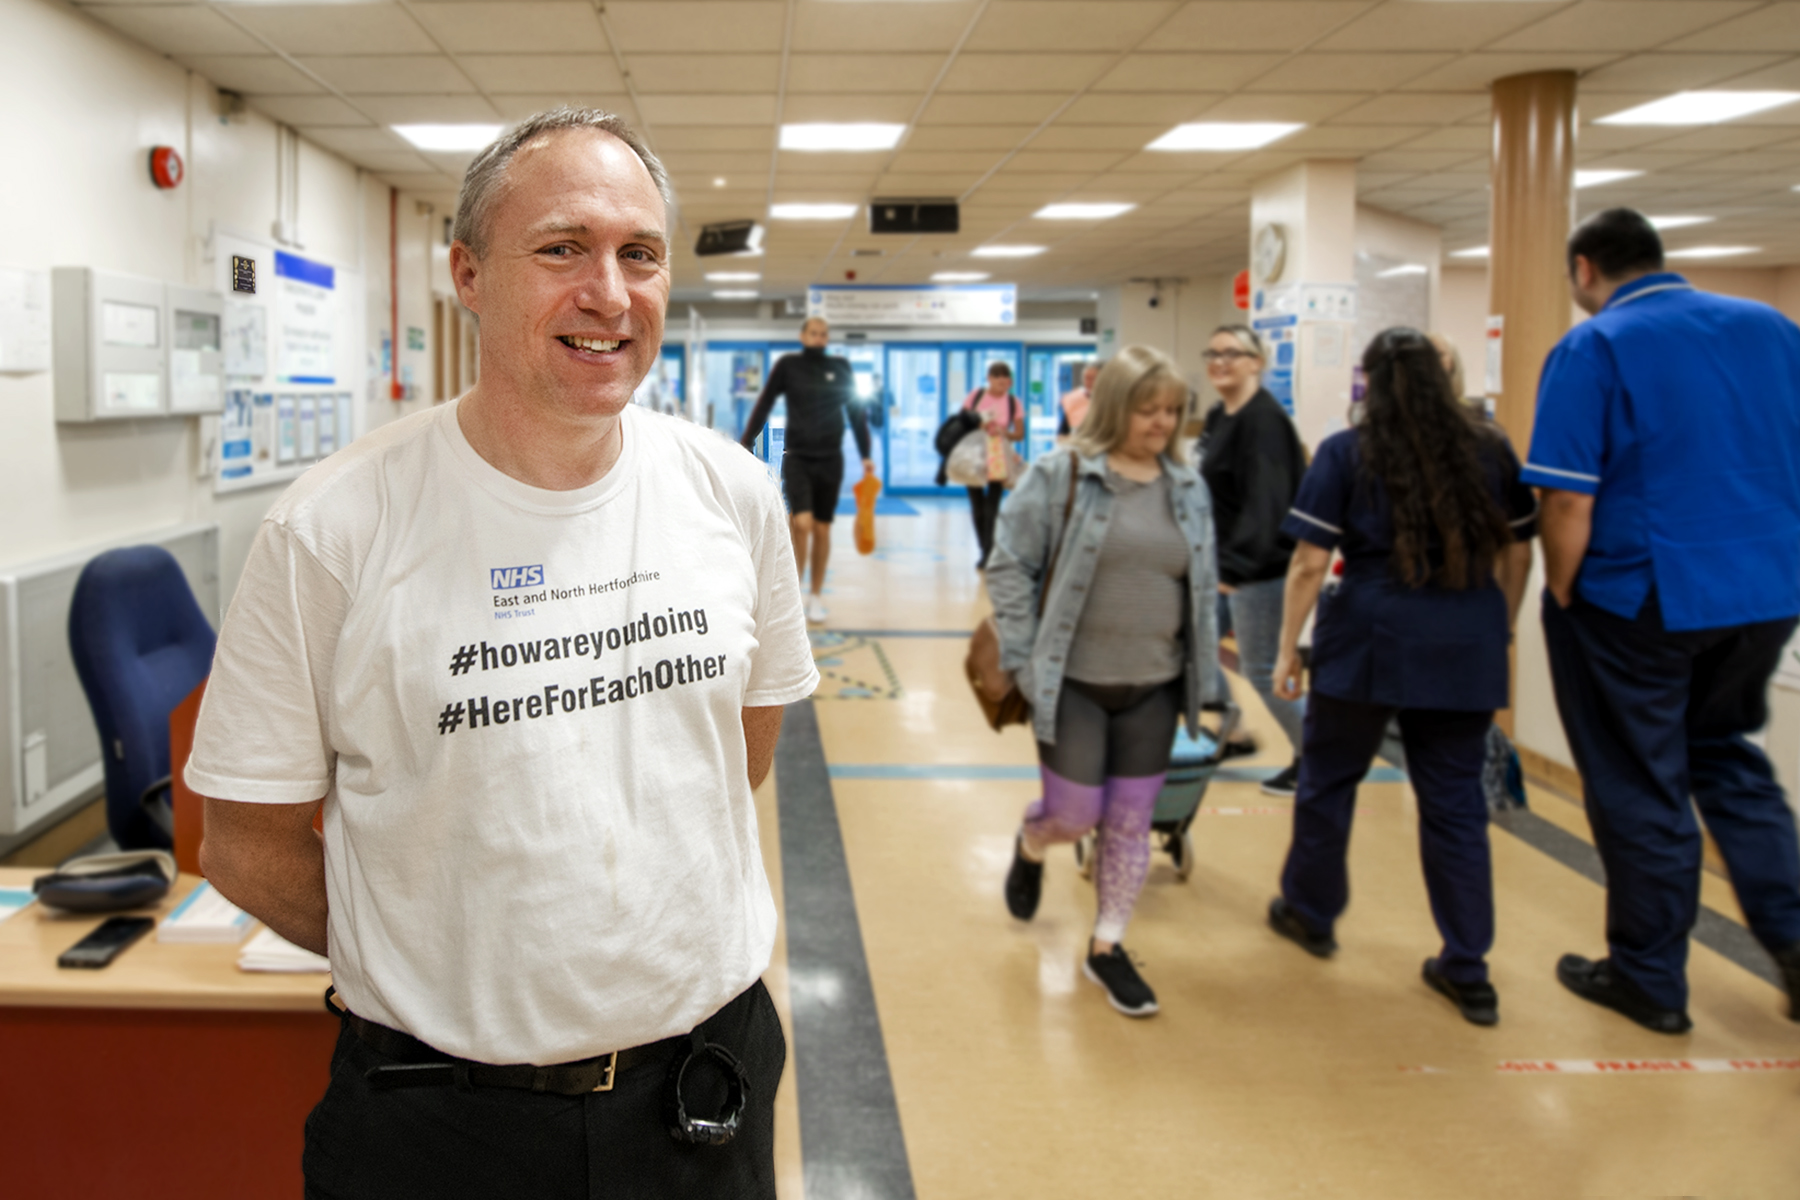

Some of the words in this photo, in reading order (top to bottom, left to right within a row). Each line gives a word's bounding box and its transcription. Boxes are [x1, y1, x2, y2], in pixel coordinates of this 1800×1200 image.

[492, 565, 544, 589] NHS
[493, 594, 520, 608] East
[523, 589, 547, 604] and
[550, 585, 586, 600] North
[589, 570, 661, 595] Hertfordshire
[494, 610, 513, 620] NHS
[514, 608, 536, 618] Trust
[449, 607, 709, 676] #howareyoudoing
[437, 653, 727, 735] #HereForEachOther
[1594, 1060, 1698, 1072] FRAGILE
